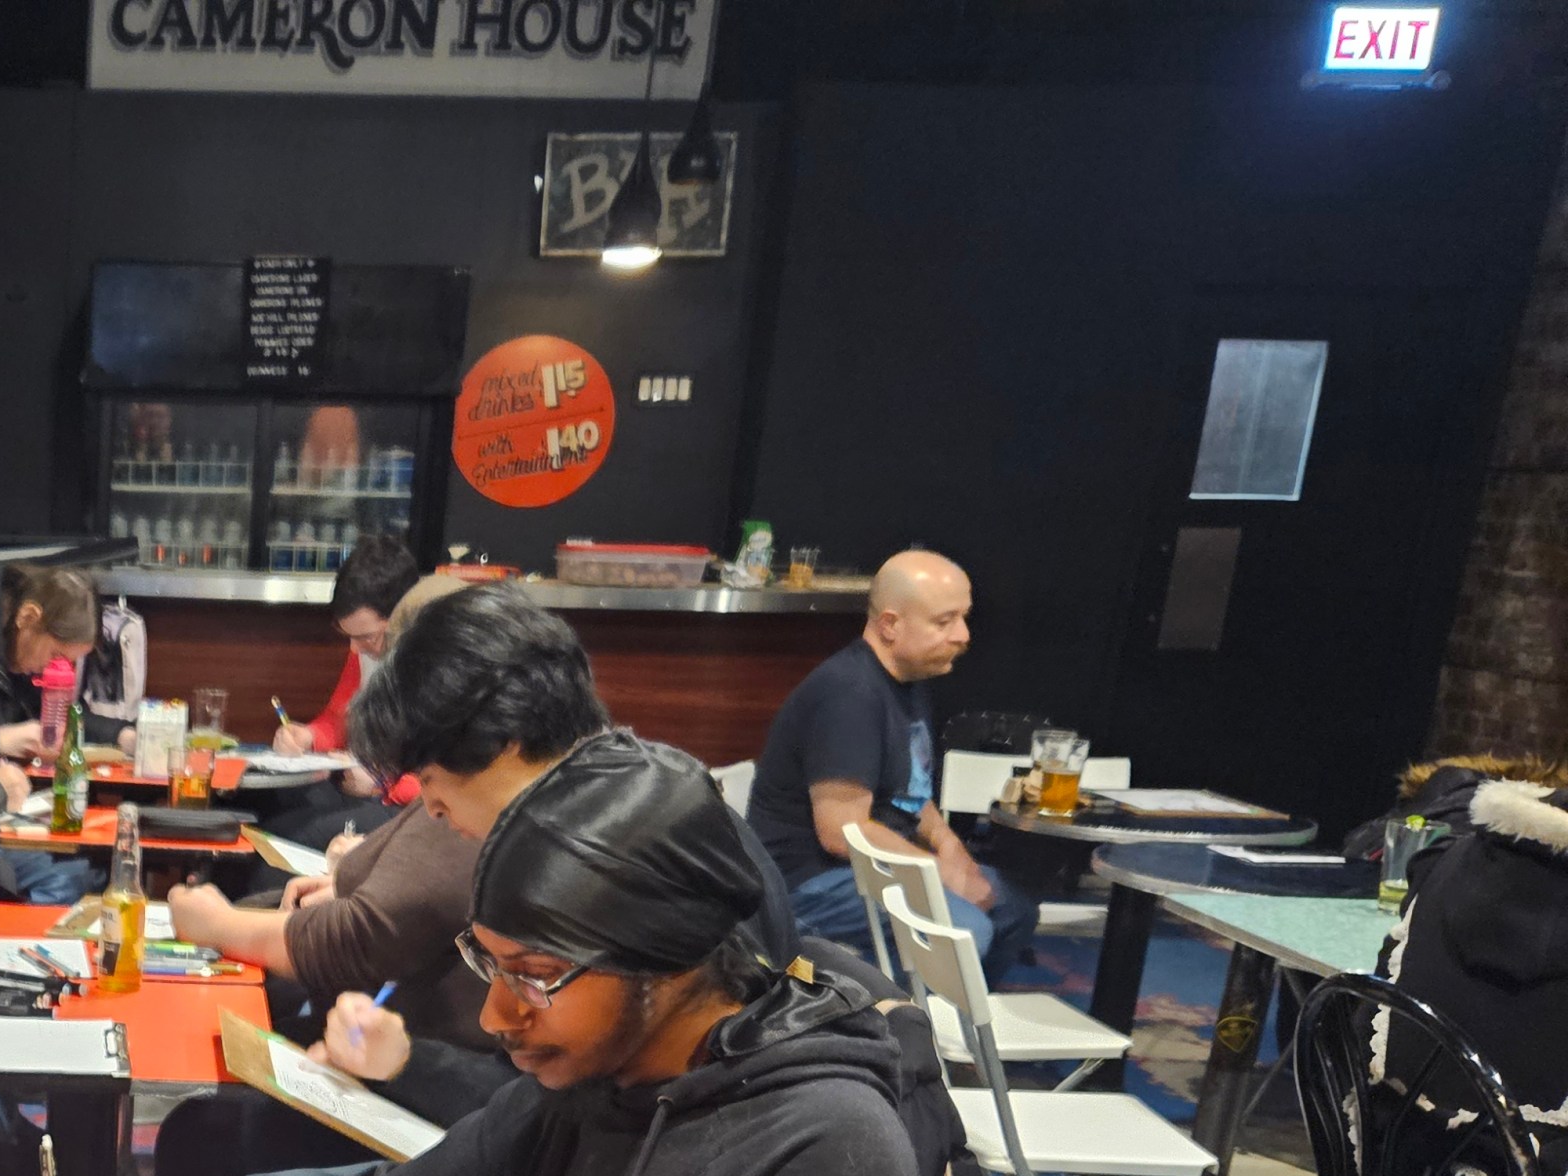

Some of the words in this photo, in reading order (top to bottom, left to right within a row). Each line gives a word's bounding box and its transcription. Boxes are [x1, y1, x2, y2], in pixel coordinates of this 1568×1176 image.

[110, 0, 435, 70] CAMERON
[452, 0, 693, 60] HOUSE
[1334, 20, 1429, 60] EXIT
